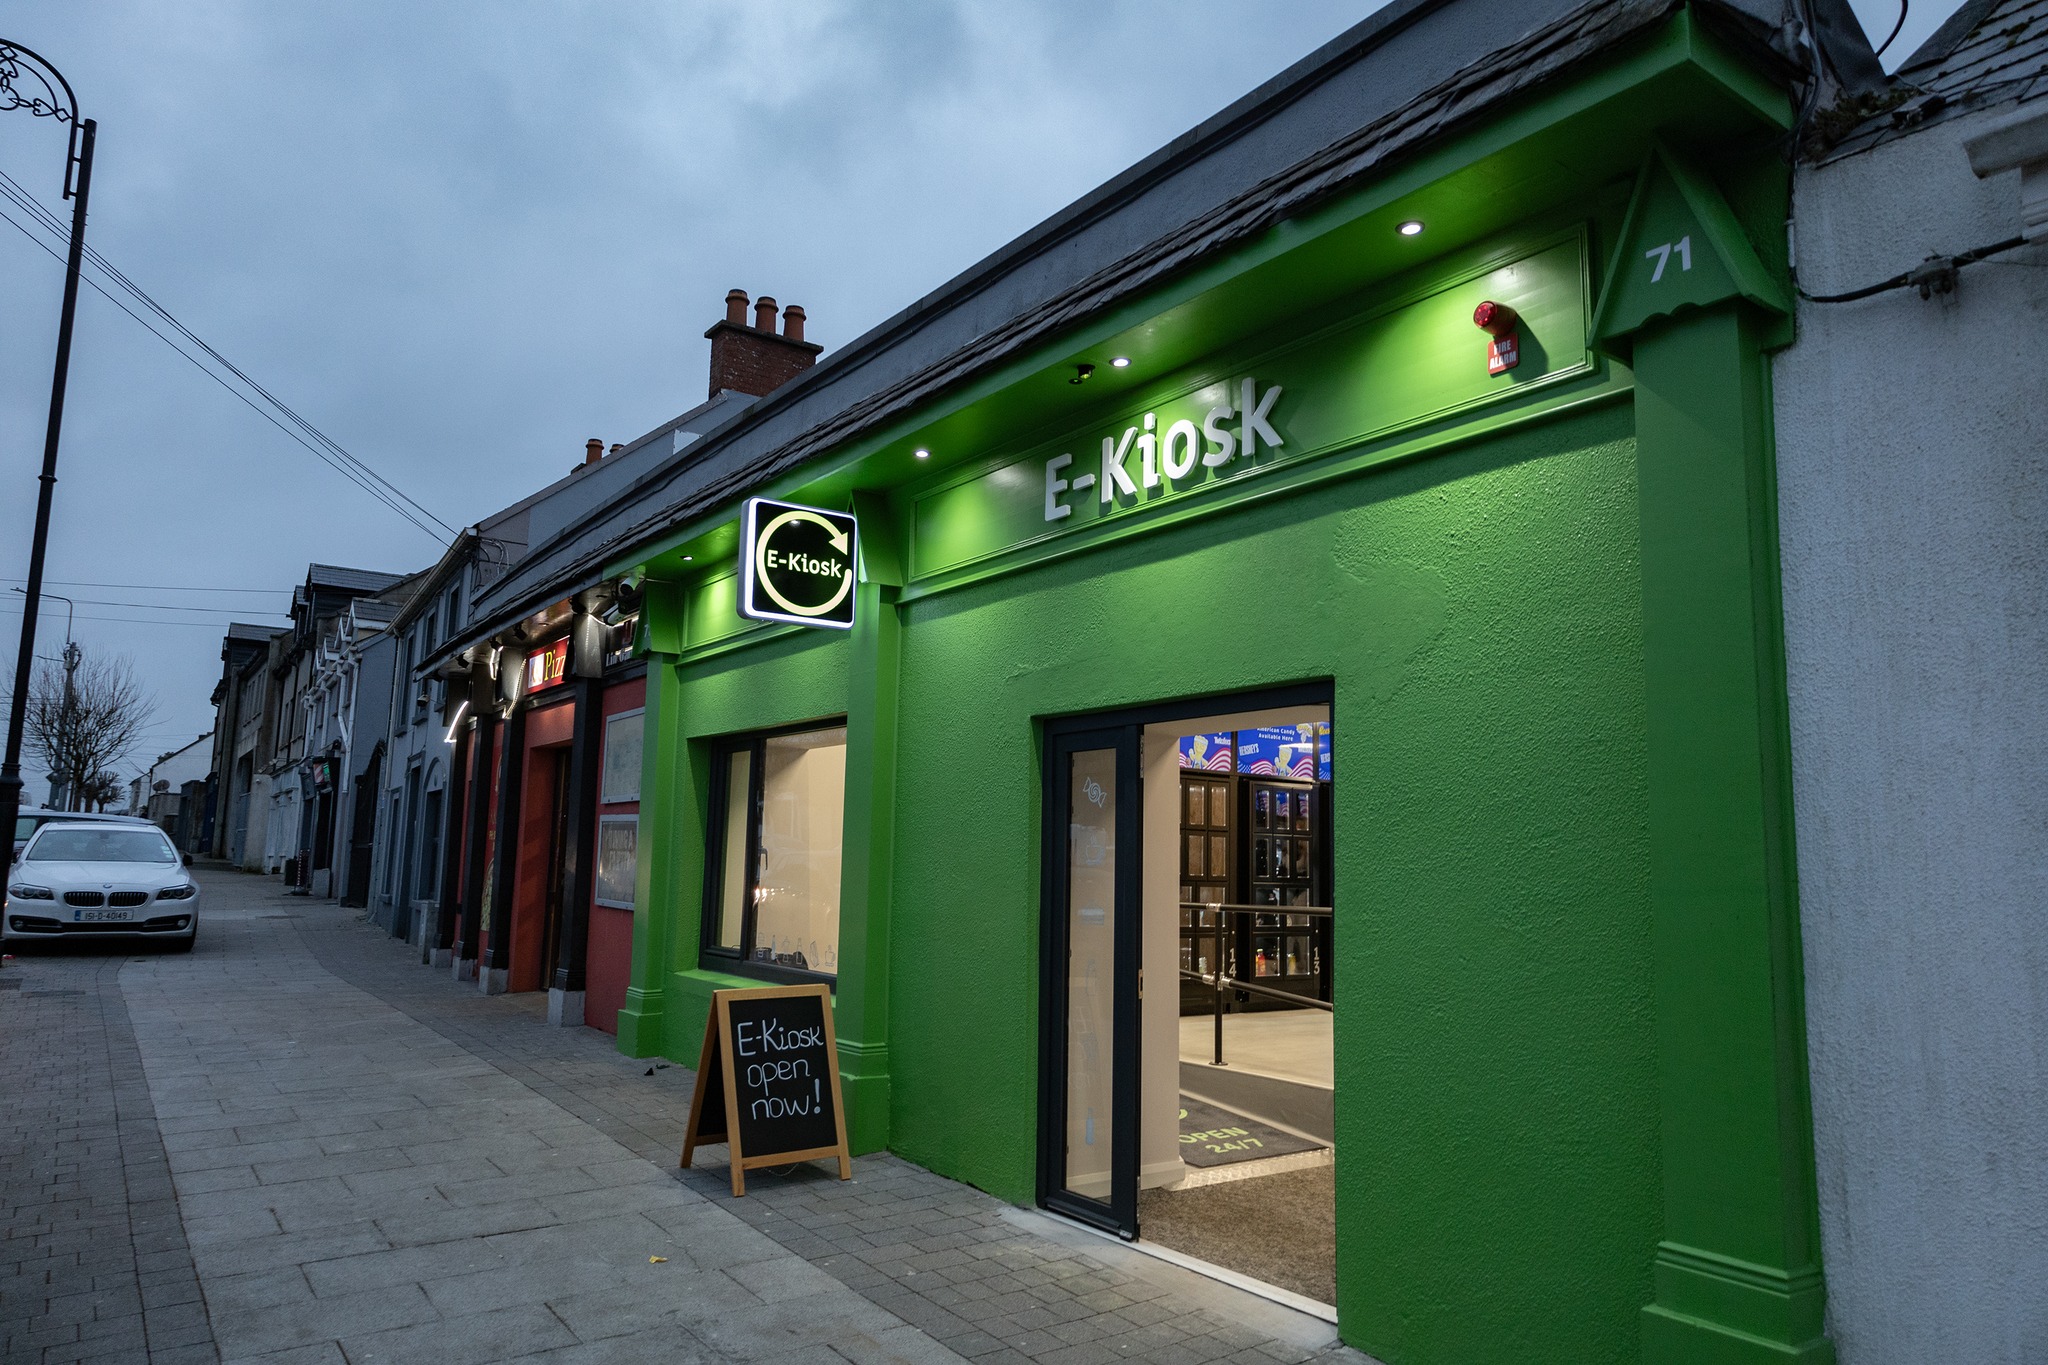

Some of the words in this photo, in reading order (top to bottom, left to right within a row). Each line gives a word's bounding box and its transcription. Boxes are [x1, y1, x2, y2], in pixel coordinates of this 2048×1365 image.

[1645, 234, 1692, 284] 71
[1493, 339, 1512, 356] FIRE
[1489, 350, 1517, 370] ALARM
[1044, 376, 1284, 522] E-Kiosk
[767, 549, 842, 578] E-Kiosk
[1258, 733, 1281, 741] Available
[1280, 728, 1295, 736] Candy
[737, 1017, 824, 1057] E-Kiosk
[747, 1058, 811, 1097] open
[751, 1078, 821, 1120] now!
[1179, 1126, 1250, 1144] OPEN
[1205, 1138, 1264, 1154] 24/7
